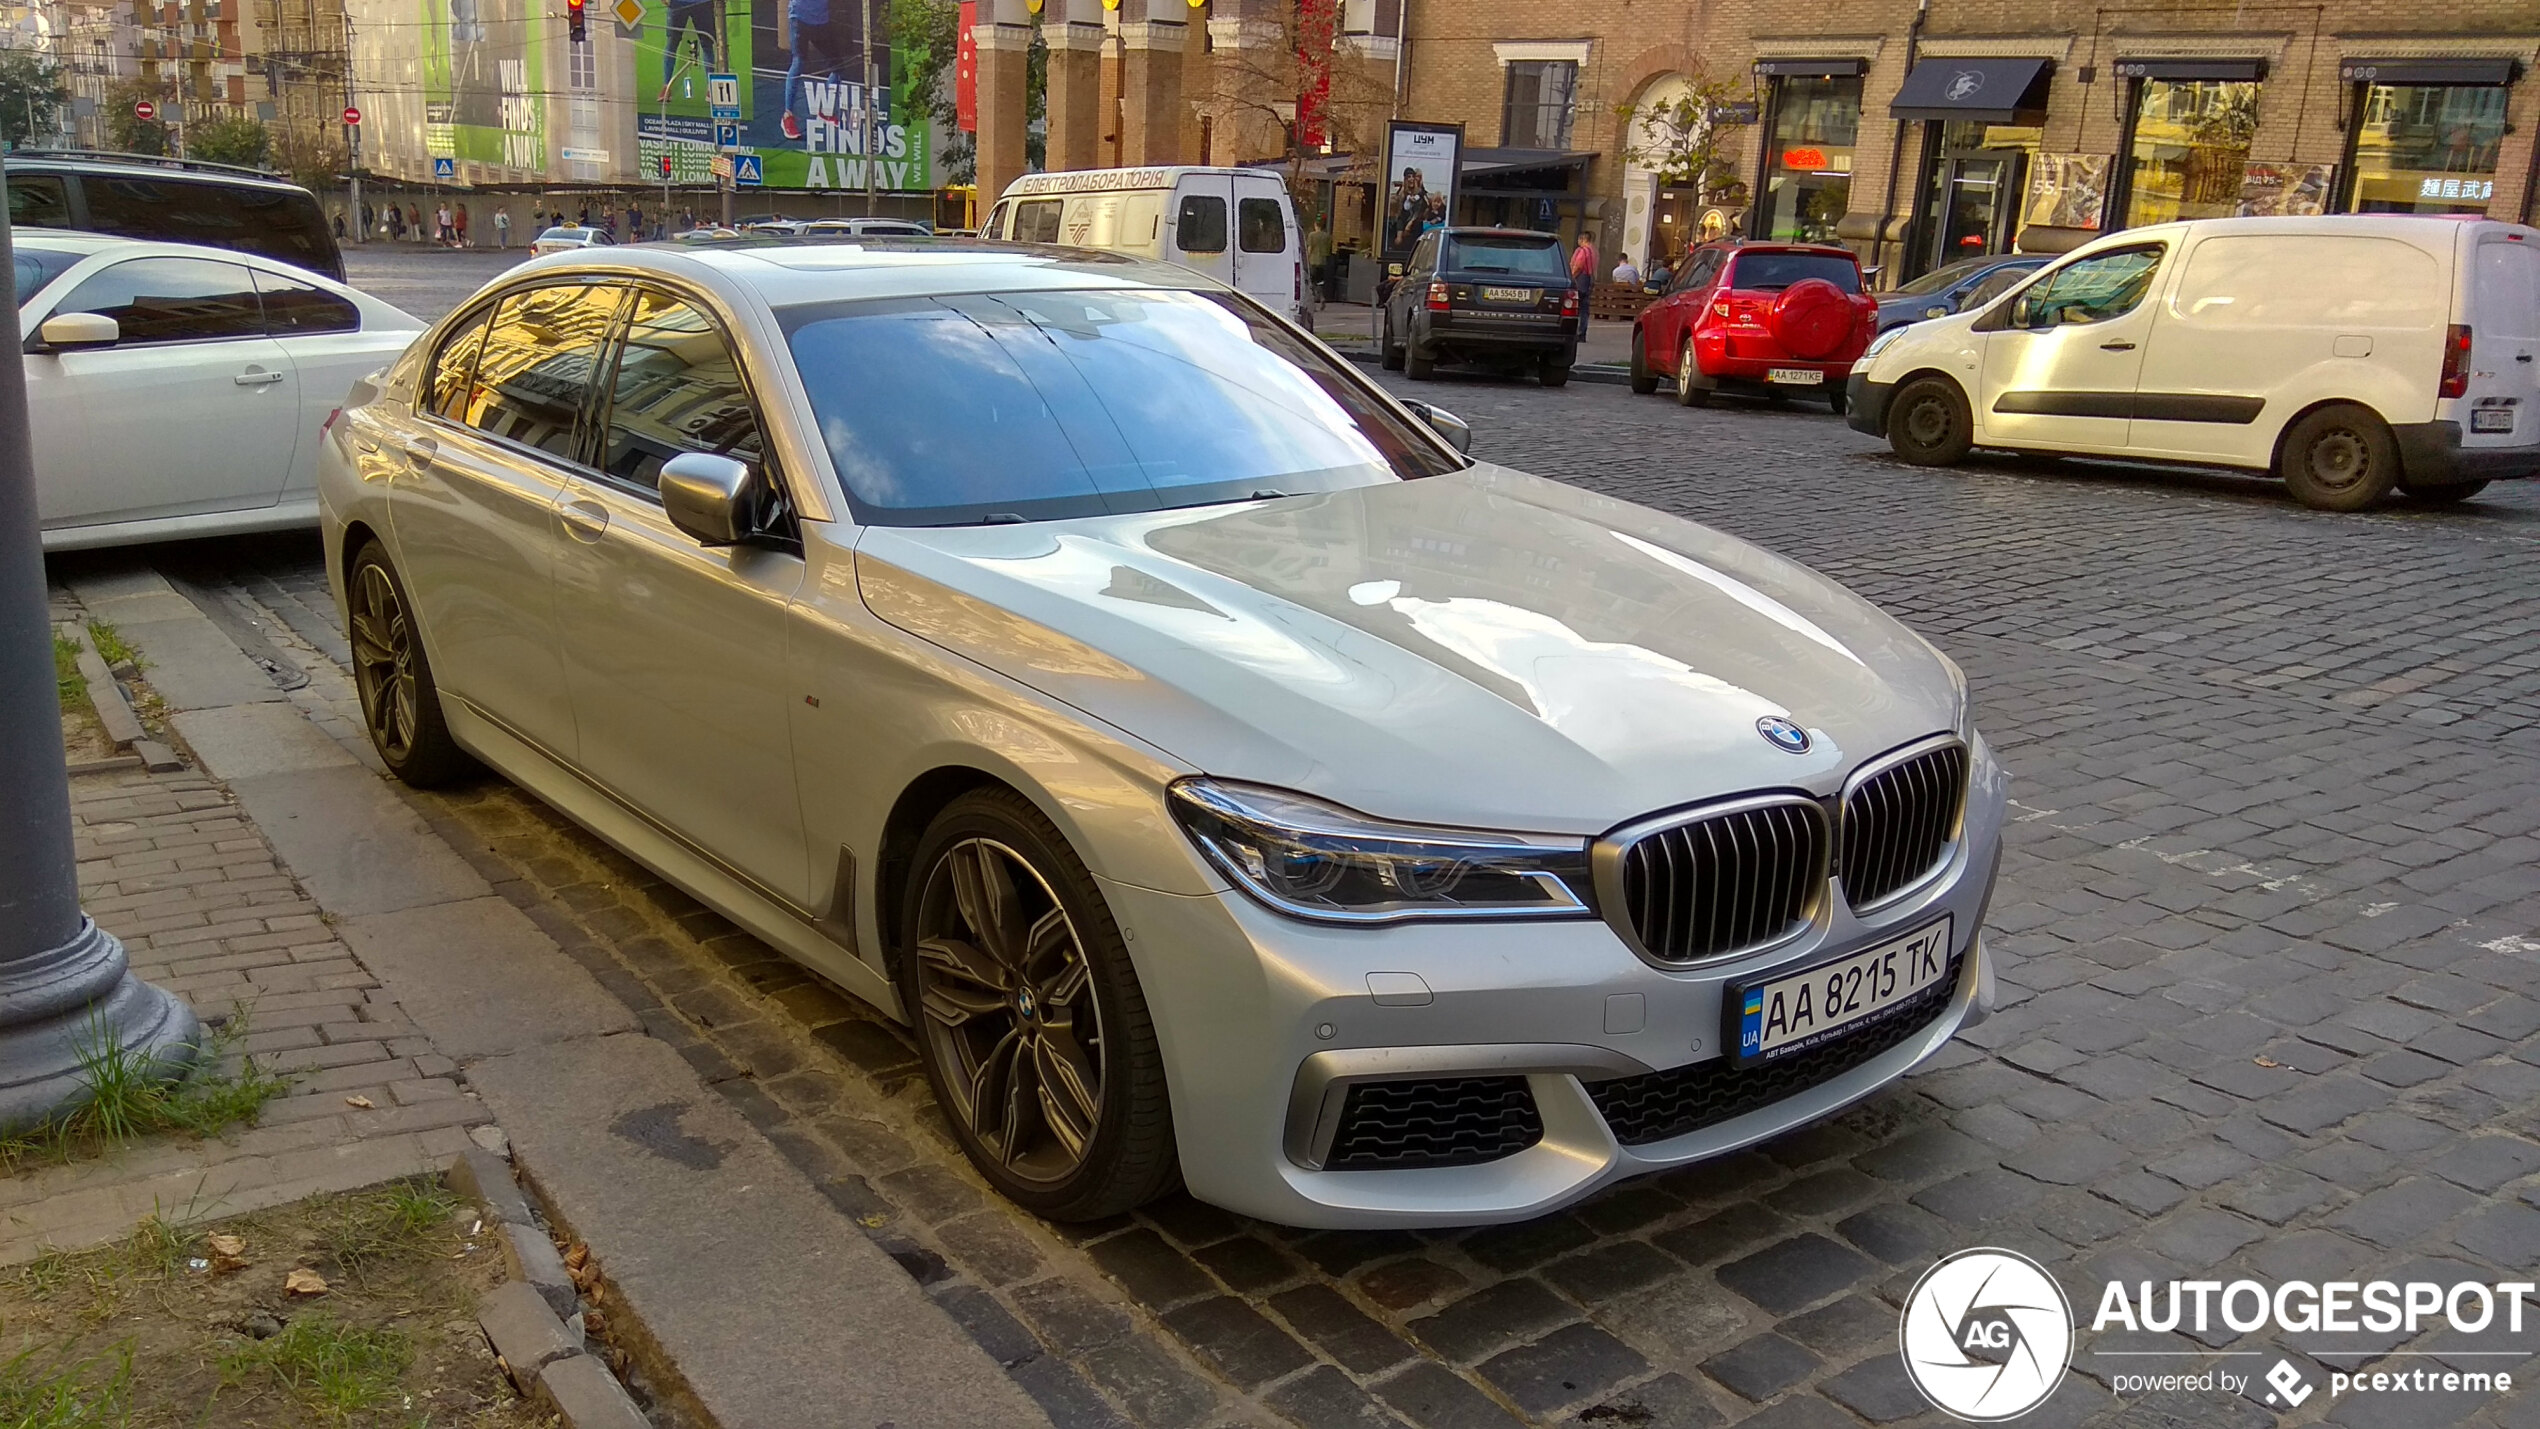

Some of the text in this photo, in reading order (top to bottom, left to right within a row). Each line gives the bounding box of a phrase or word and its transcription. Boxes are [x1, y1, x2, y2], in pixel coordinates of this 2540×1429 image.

[500, 60, 528, 92] WILL
[502, 98, 536, 132] FINDS
[804, 82, 888, 120] WILL
[806, 119, 906, 158] FINDS
[1414, 134, 1434, 144] ЦУМ
[914, 131, 922, 182] WE WILL
[806, 157, 908, 190] A WAY
[1024, 170, 1165, 192] ЕЛЕКТРОЛАБОРАТОРІЯ
[1774, 370, 1821, 380] AA 1271 KE
[1763, 930, 1942, 1042] AA 8215 TK
[1742, 1030, 1759, 1048] UA
